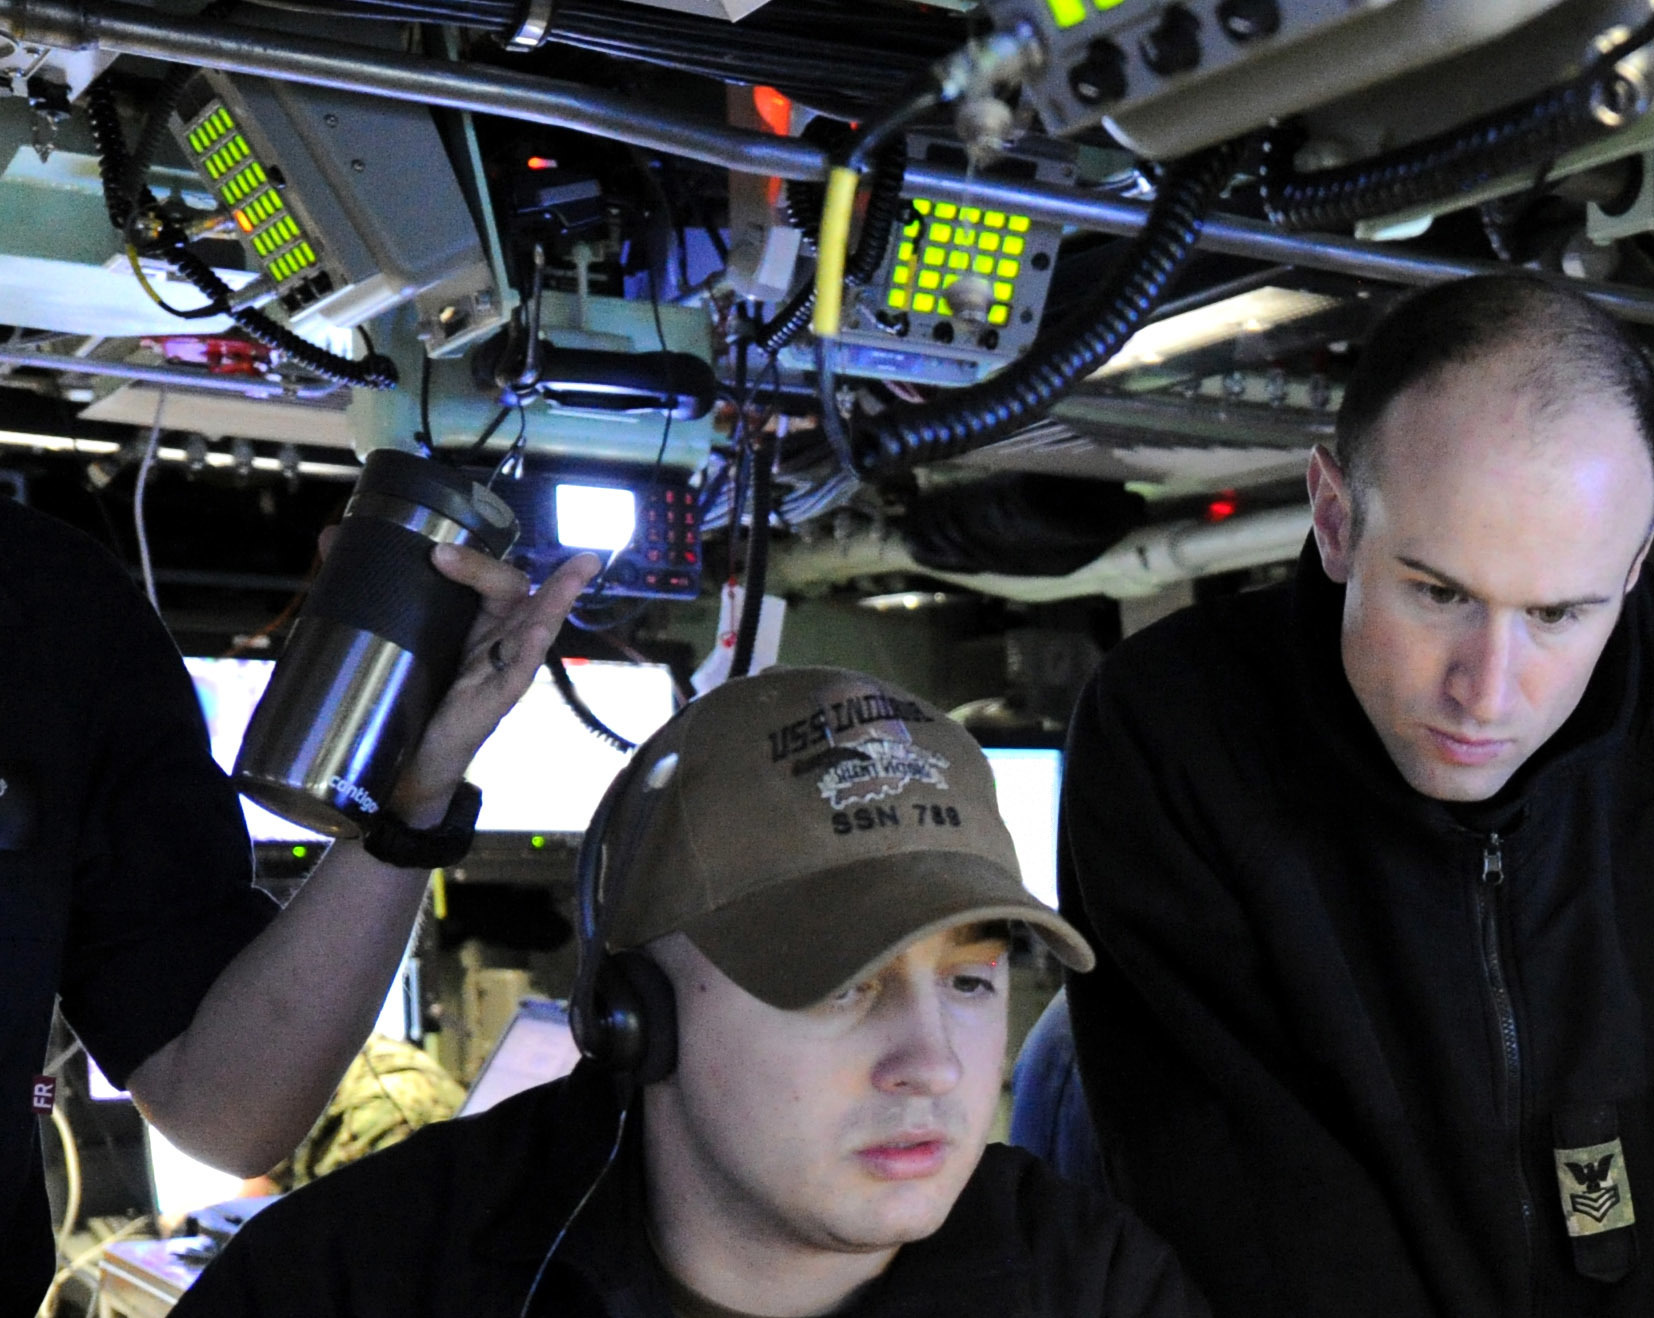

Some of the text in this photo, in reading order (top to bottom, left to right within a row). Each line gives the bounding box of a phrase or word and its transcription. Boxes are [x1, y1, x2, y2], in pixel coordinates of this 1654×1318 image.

[769, 710, 831, 765] USS
[328, 775, 379, 814] contigo
[831, 803, 962, 835] SSN 789
[33, 1083, 54, 1109] FR
